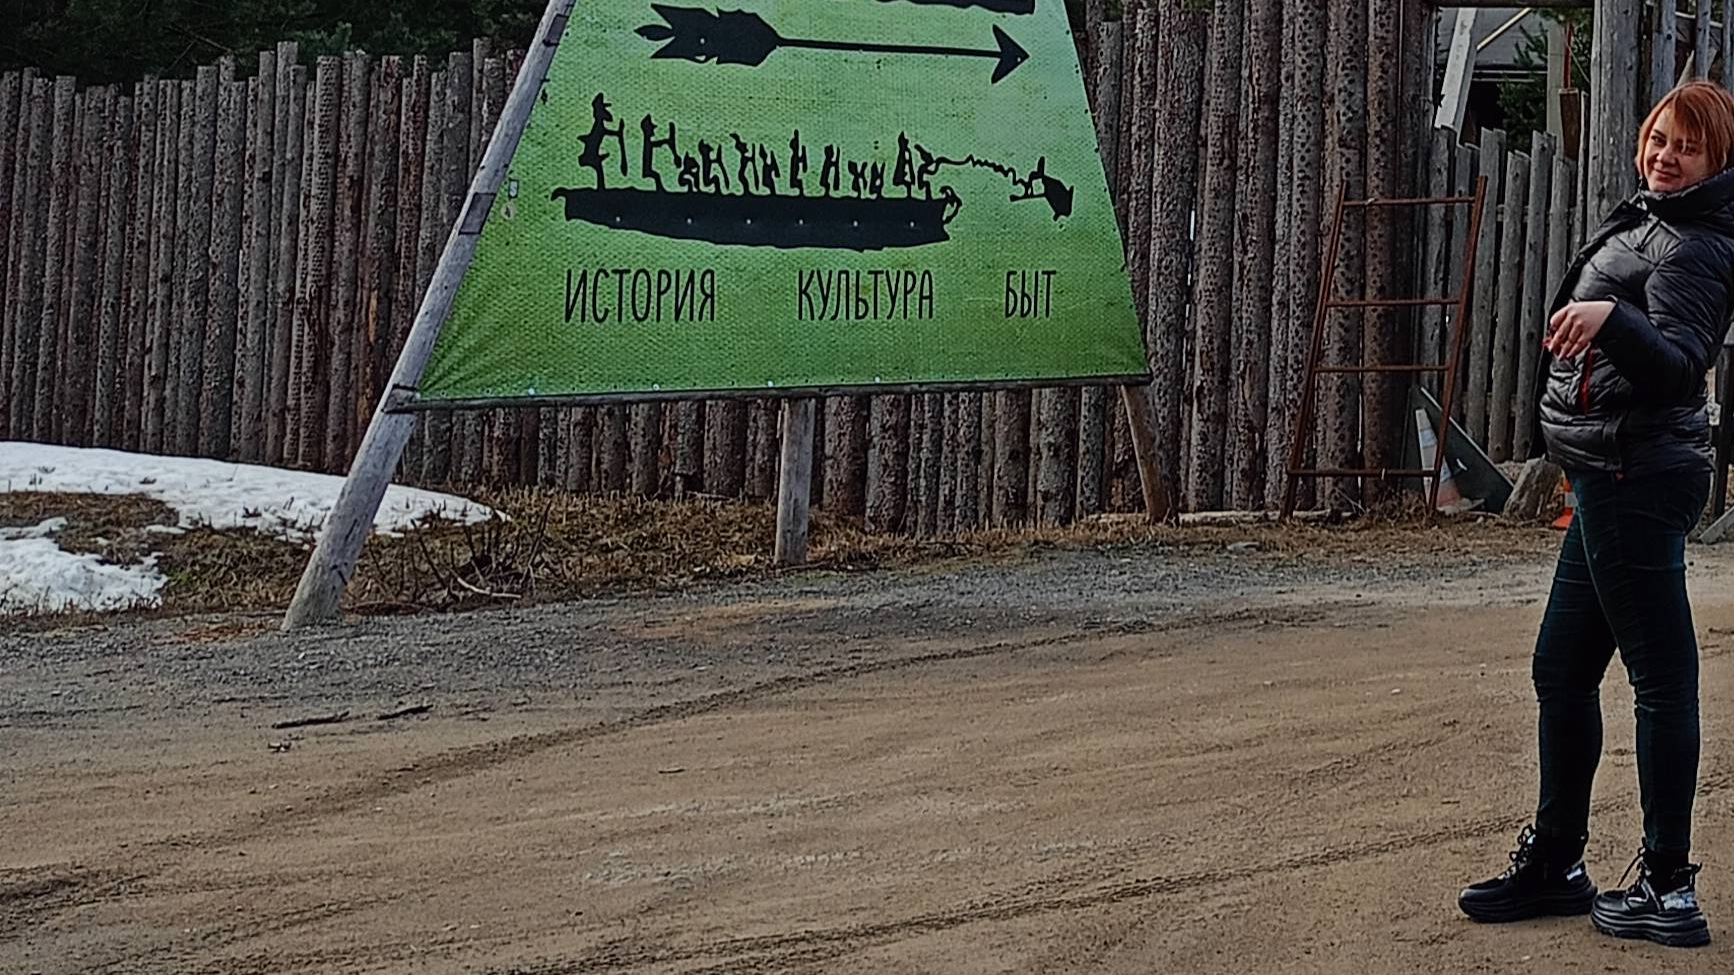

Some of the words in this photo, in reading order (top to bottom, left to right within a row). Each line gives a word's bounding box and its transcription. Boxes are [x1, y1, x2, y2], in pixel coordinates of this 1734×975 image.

[564, 268, 717, 324] ИСТОРИЯ
[797, 269, 935, 322] КУЛЬТУРА
[1004, 269, 1057, 319] БЫТ
